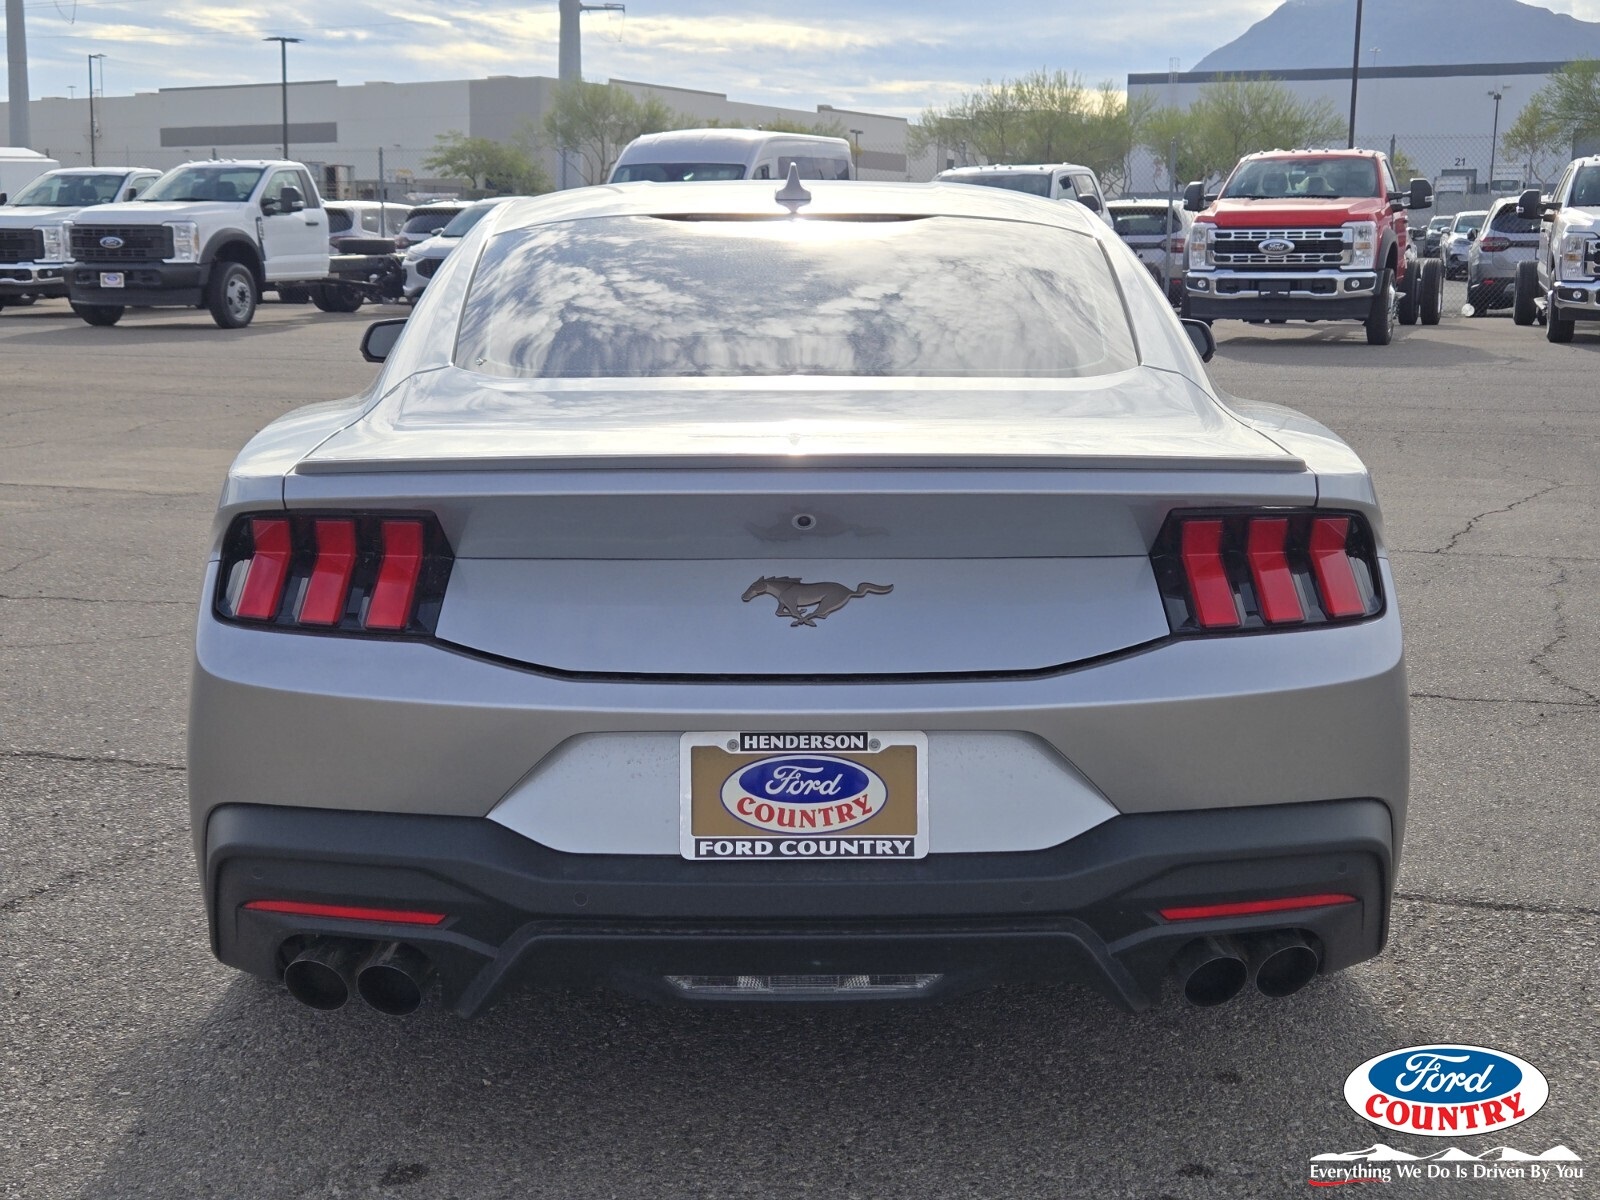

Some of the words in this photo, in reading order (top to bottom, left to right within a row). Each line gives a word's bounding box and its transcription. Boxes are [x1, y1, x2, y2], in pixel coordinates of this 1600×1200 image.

[1455, 157, 1466, 166] 21
[1268, 242, 1285, 251] Ford
[744, 734, 864, 749] HENDERSON
[765, 765, 843, 795] Ford
[737, 794, 872, 828] COUNTRY
[700, 841, 774, 856] FORD
[779, 841, 911, 856] COUNTRY
